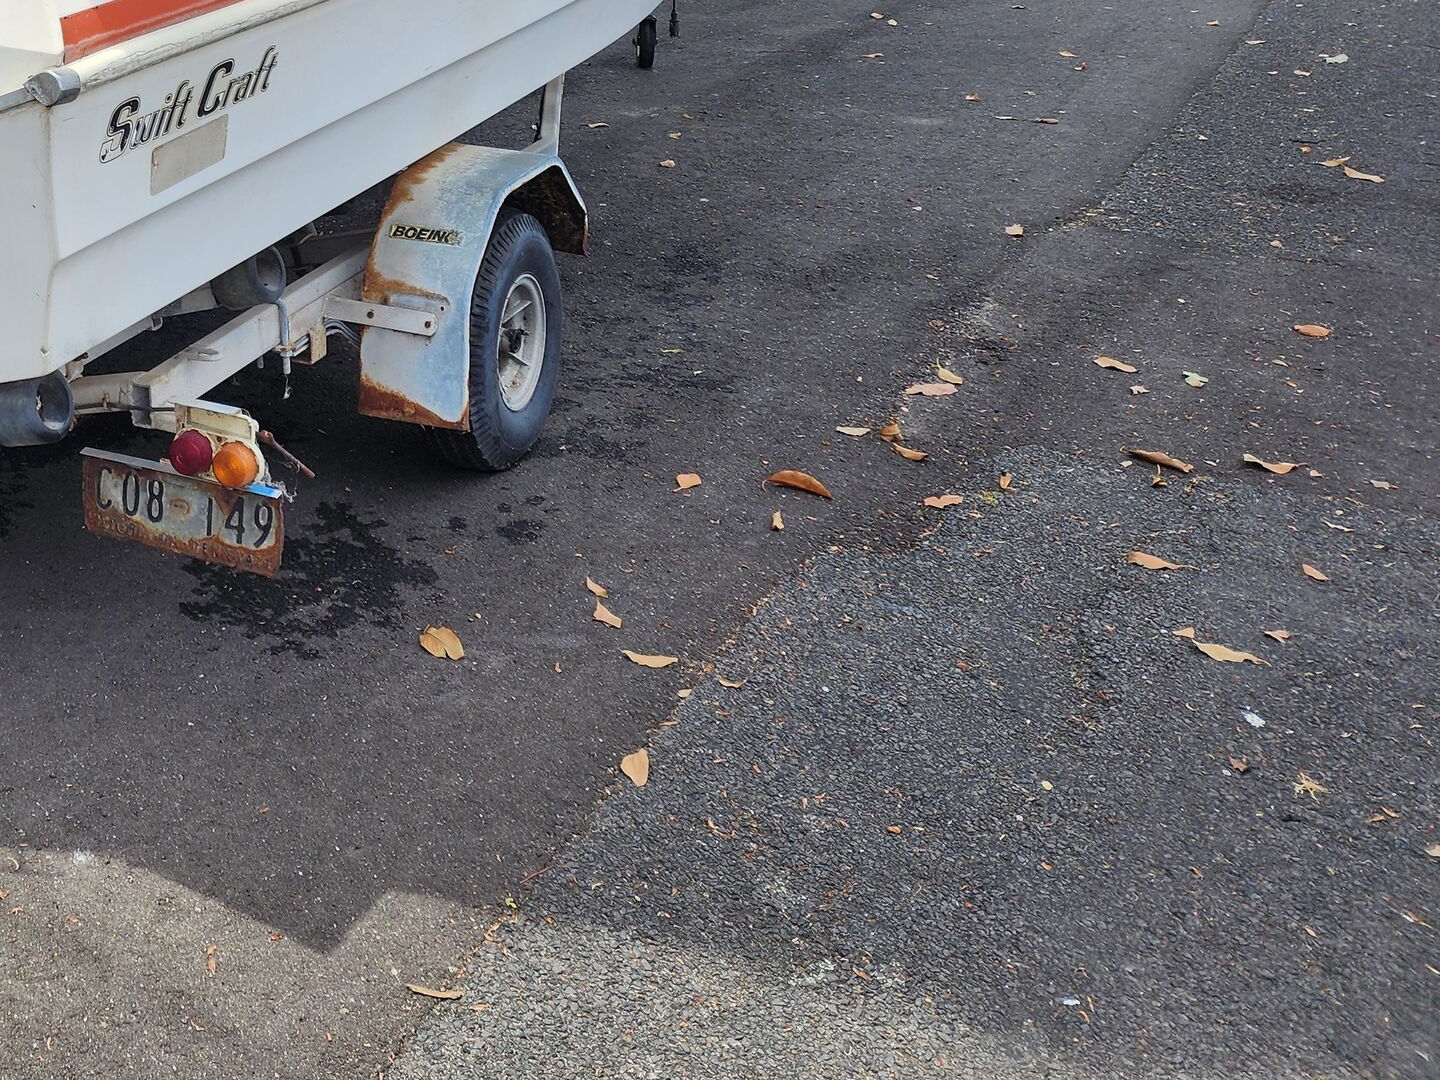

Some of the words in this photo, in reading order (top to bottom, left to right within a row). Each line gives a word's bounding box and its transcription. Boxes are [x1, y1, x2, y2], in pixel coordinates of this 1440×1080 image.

[99, 80, 194, 163] Swift
[197, 44, 278, 118] Craft
[206, 495, 274, 549] 149
